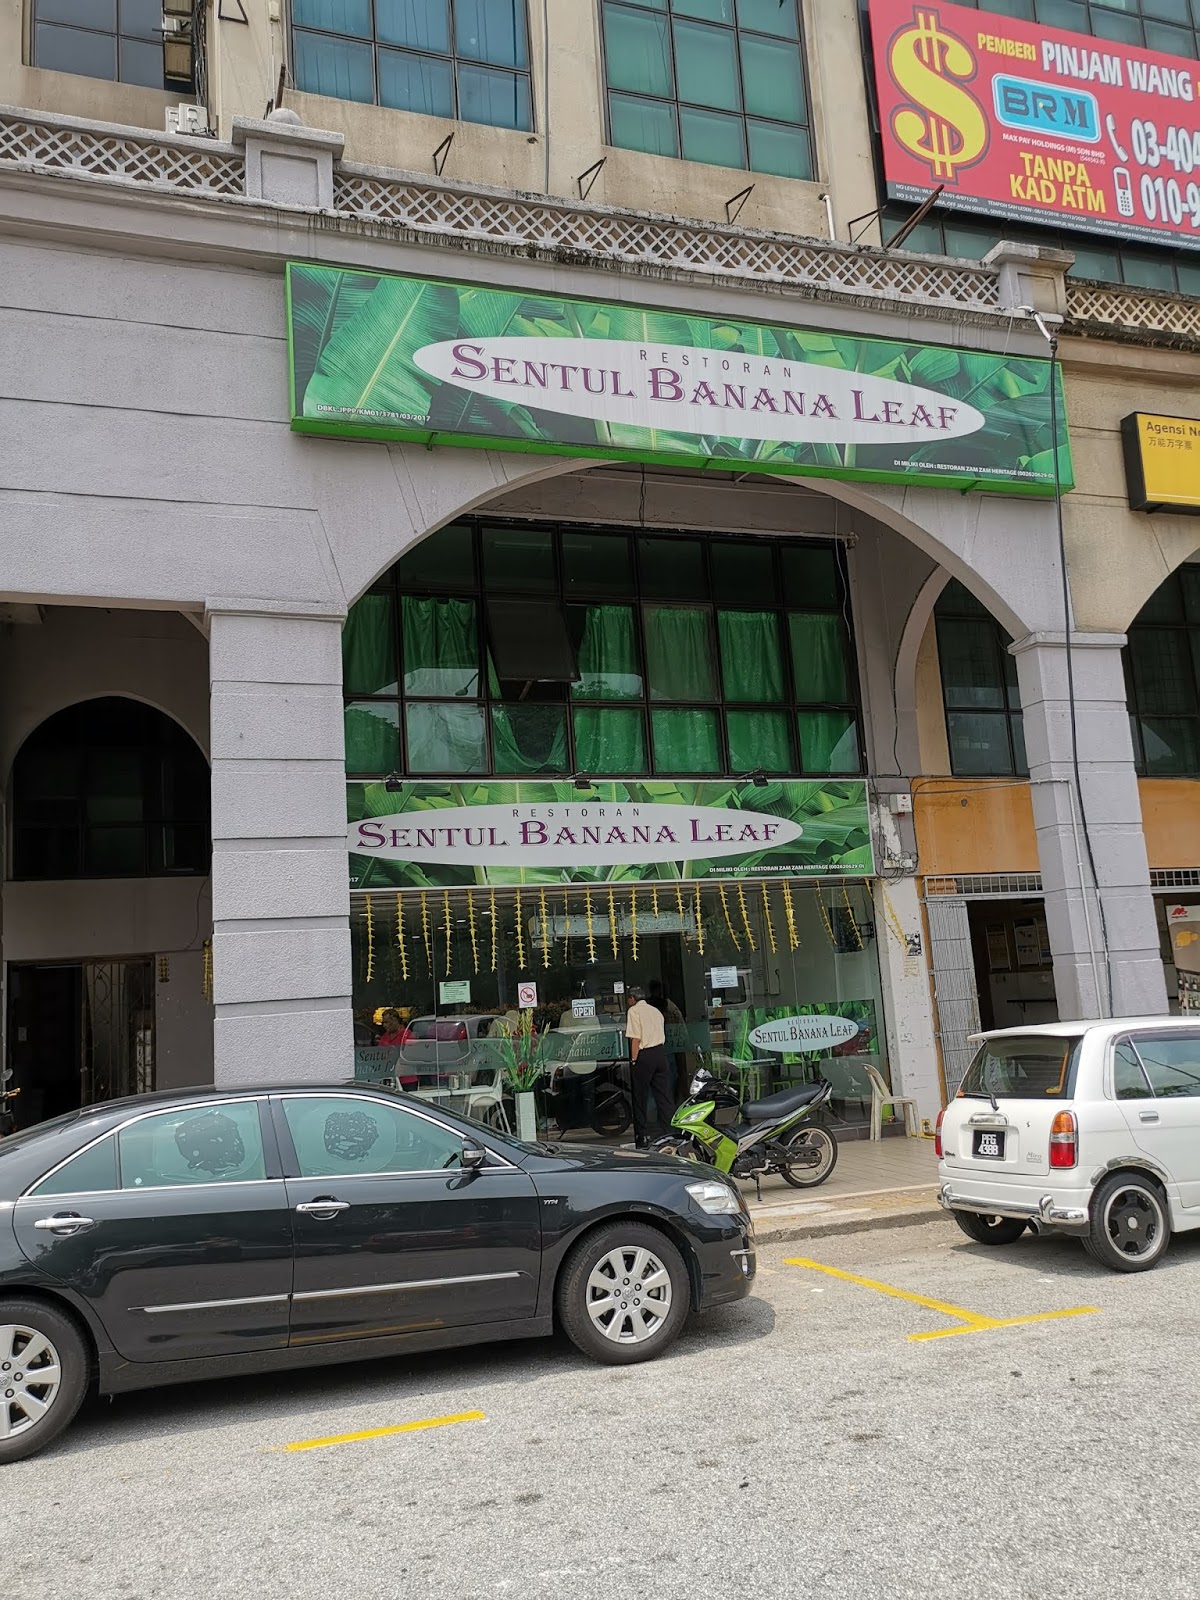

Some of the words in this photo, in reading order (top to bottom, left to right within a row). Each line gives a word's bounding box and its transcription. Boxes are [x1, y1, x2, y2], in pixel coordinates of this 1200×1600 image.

[977, 32, 1037, 62] PEMBERI
[1041, 40, 1123, 87] PINJAM
[1126, 59, 1194, 102] WANG
[1002, 84, 1090, 129] BRM
[1002, 133, 1018, 142] MAX
[1018, 136, 1031, 145] PAY
[1031, 138, 1066, 152] HOLDINGS
[1076, 147, 1091, 156] SDN
[1020, 152, 1092, 188] TANPA
[1009, 173, 1057, 205] KAD
[1062, 183, 1107, 213] ATM
[639, 349, 793, 379] RESTORAN
[451, 343, 637, 399] SENTUL
[648, 366, 840, 419] BANANA
[852, 389, 960, 431] LEAF
[1146, 421, 1186, 435] Agensi
[937, 463, 966, 471] RESTORAN
[991, 468, 1017, 476] HERITAGE
[512, 807, 640, 818] RESTORAN
[356, 822, 510, 849] SENTUL
[518, 819, 681, 847] BANANA
[689, 817, 782, 843] LEAF
[573, 1006, 594, 1017] OPEN
[755, 1029, 789, 1044] SENTUL
[789, 1026, 829, 1041] BANANA
[829, 1022, 854, 1037] LEAF
[981, 1133, 997, 1145] PFG
